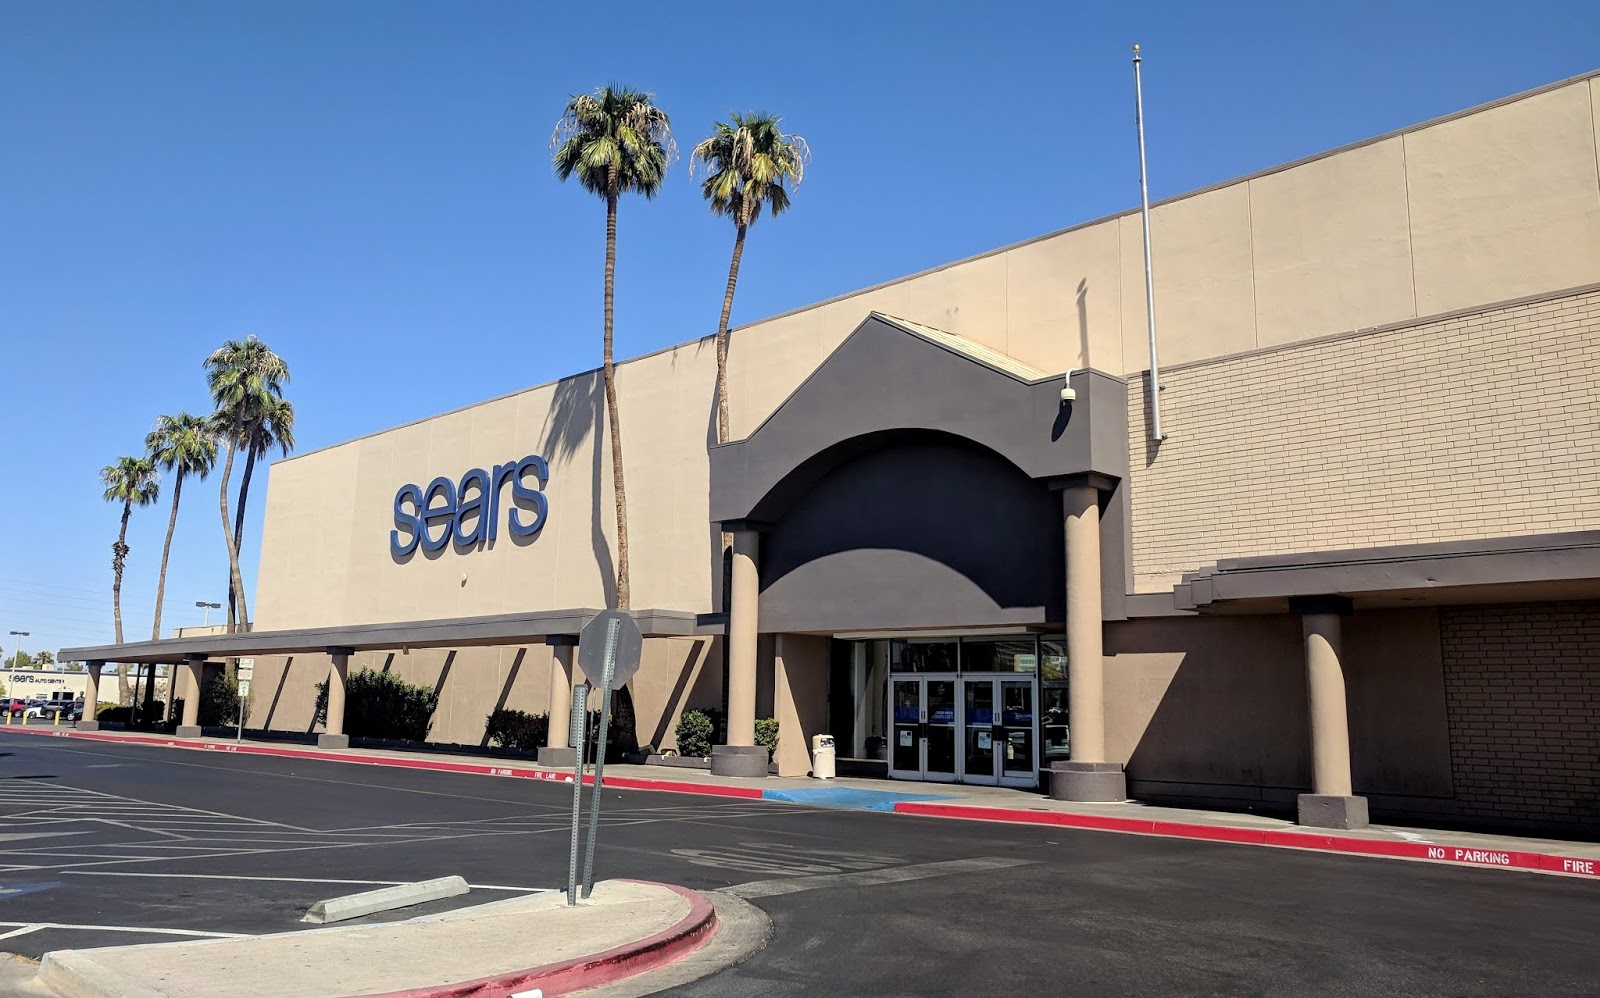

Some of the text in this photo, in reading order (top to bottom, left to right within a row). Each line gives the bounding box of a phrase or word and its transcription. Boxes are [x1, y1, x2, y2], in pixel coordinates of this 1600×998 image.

[390, 454, 549, 557] sears
[1428, 847, 1595, 874] NO PARKING FIRE
